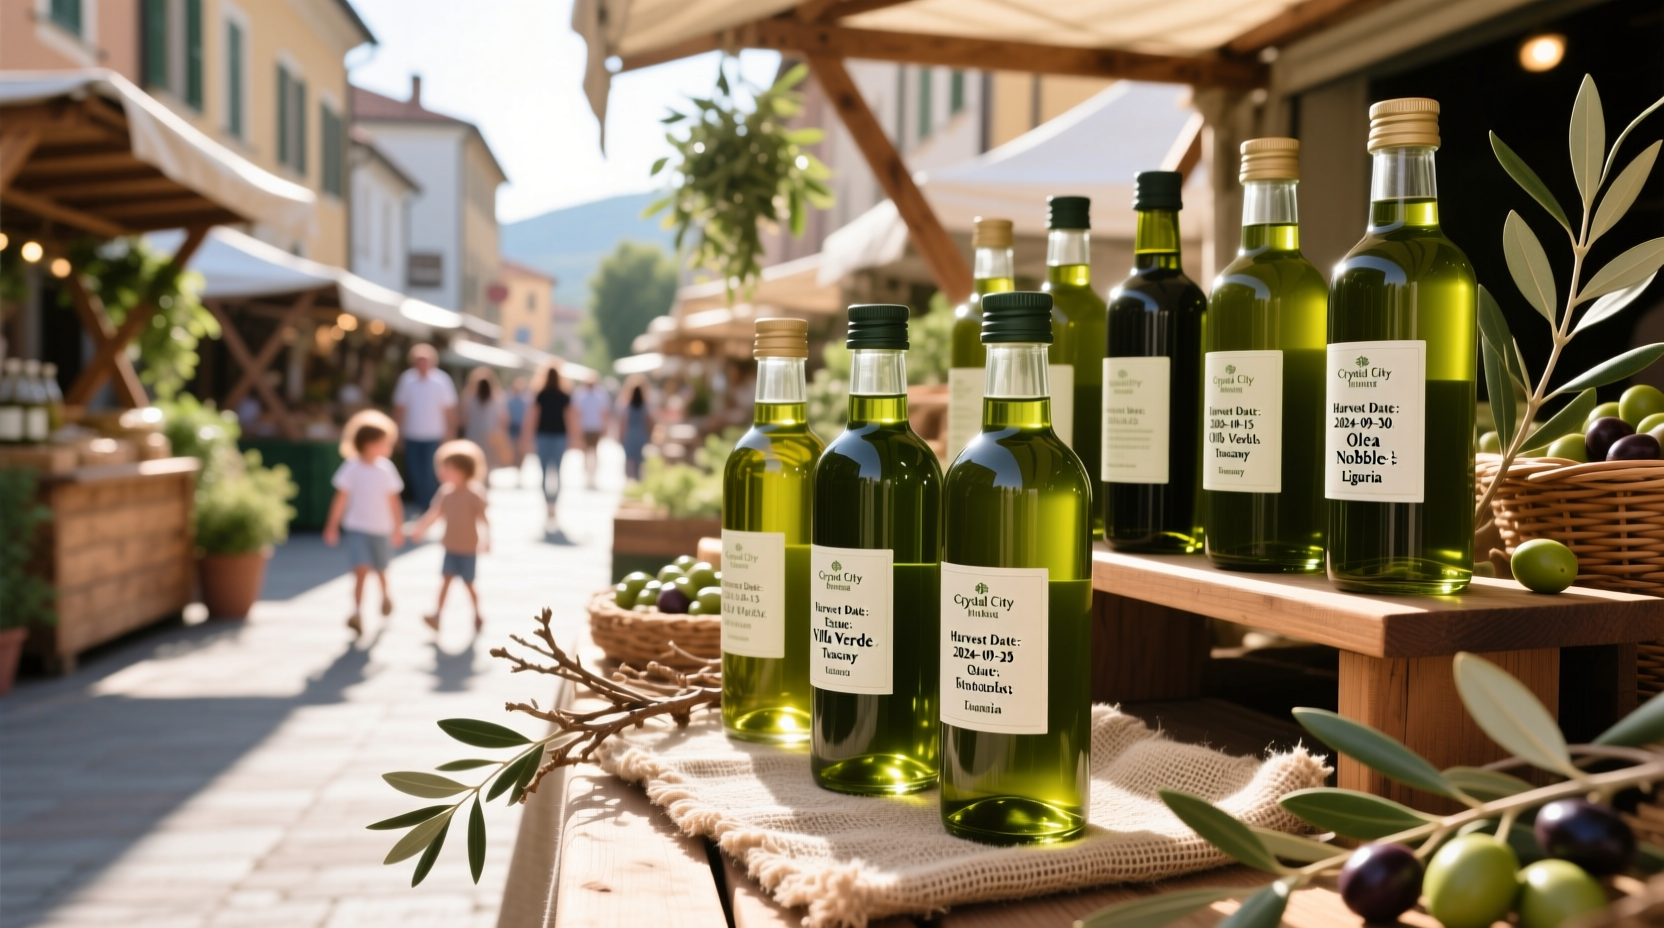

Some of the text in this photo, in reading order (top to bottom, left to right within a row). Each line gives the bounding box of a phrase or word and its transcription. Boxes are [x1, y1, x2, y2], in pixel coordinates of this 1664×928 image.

[1371, 367, 1392, 380] City
[1369, 402, 1399, 413] Date:
[1346, 432, 1380, 447] Olea
[1342, 470, 1382, 486] Liguria
[990, 595, 1014, 611] City
[834, 631, 874, 648] Verde
[990, 633, 1021, 647] Date:
